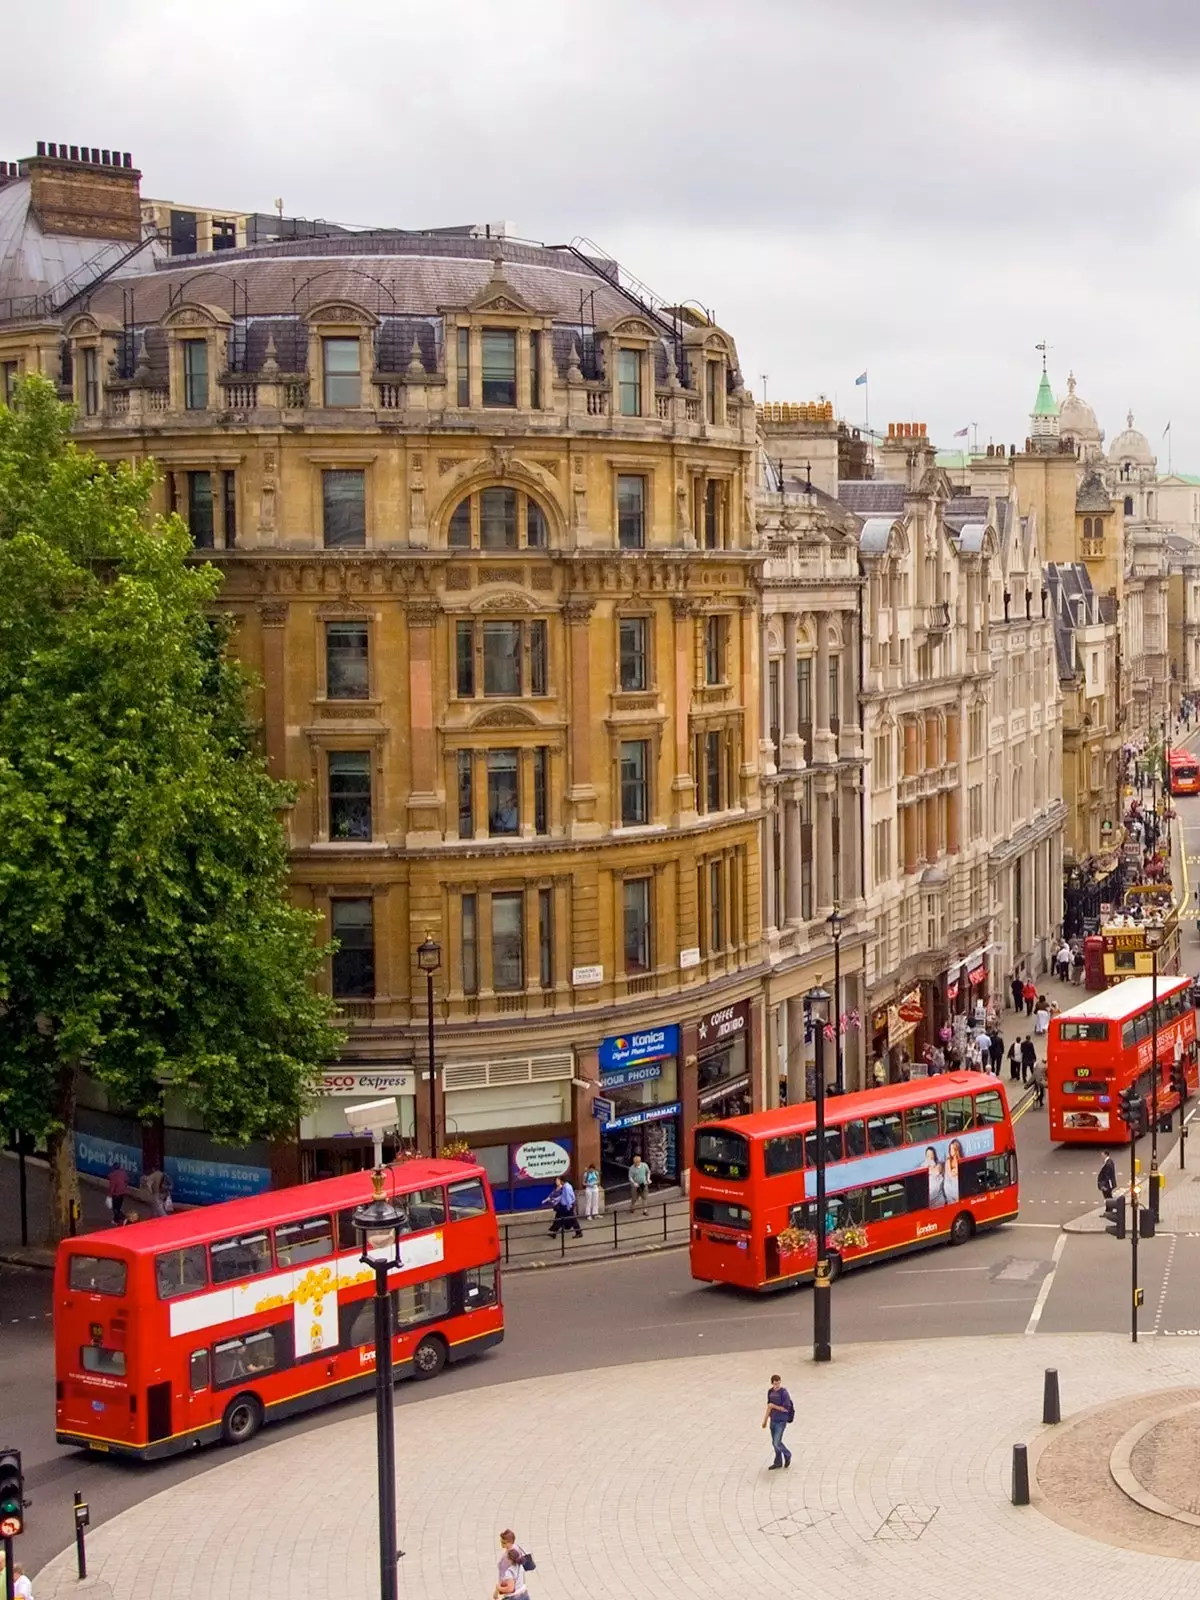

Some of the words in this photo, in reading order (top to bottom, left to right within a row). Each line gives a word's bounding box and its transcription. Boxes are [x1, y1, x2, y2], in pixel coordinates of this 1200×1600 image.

[710, 1006, 735, 1027] COFFEE
[631, 1031, 665, 1048] Konica
[601, 1074, 625, 1087] HOUR
[628, 1066, 661, 1081] PHOTOS
[1077, 1069, 1089, 1077] 159
[359, 1075, 406, 1088] express
[645, 1106, 677, 1118] PHARMACY
[623, 1115, 642, 1124] STORE
[79, 1143, 106, 1164] Open
[540, 1158, 567, 1166] everyday
[177, 1159, 215, 1176] What's
[219, 1166, 230, 1178] in
[231, 1168, 260, 1182] store
[916, 1223, 938, 1235] London
